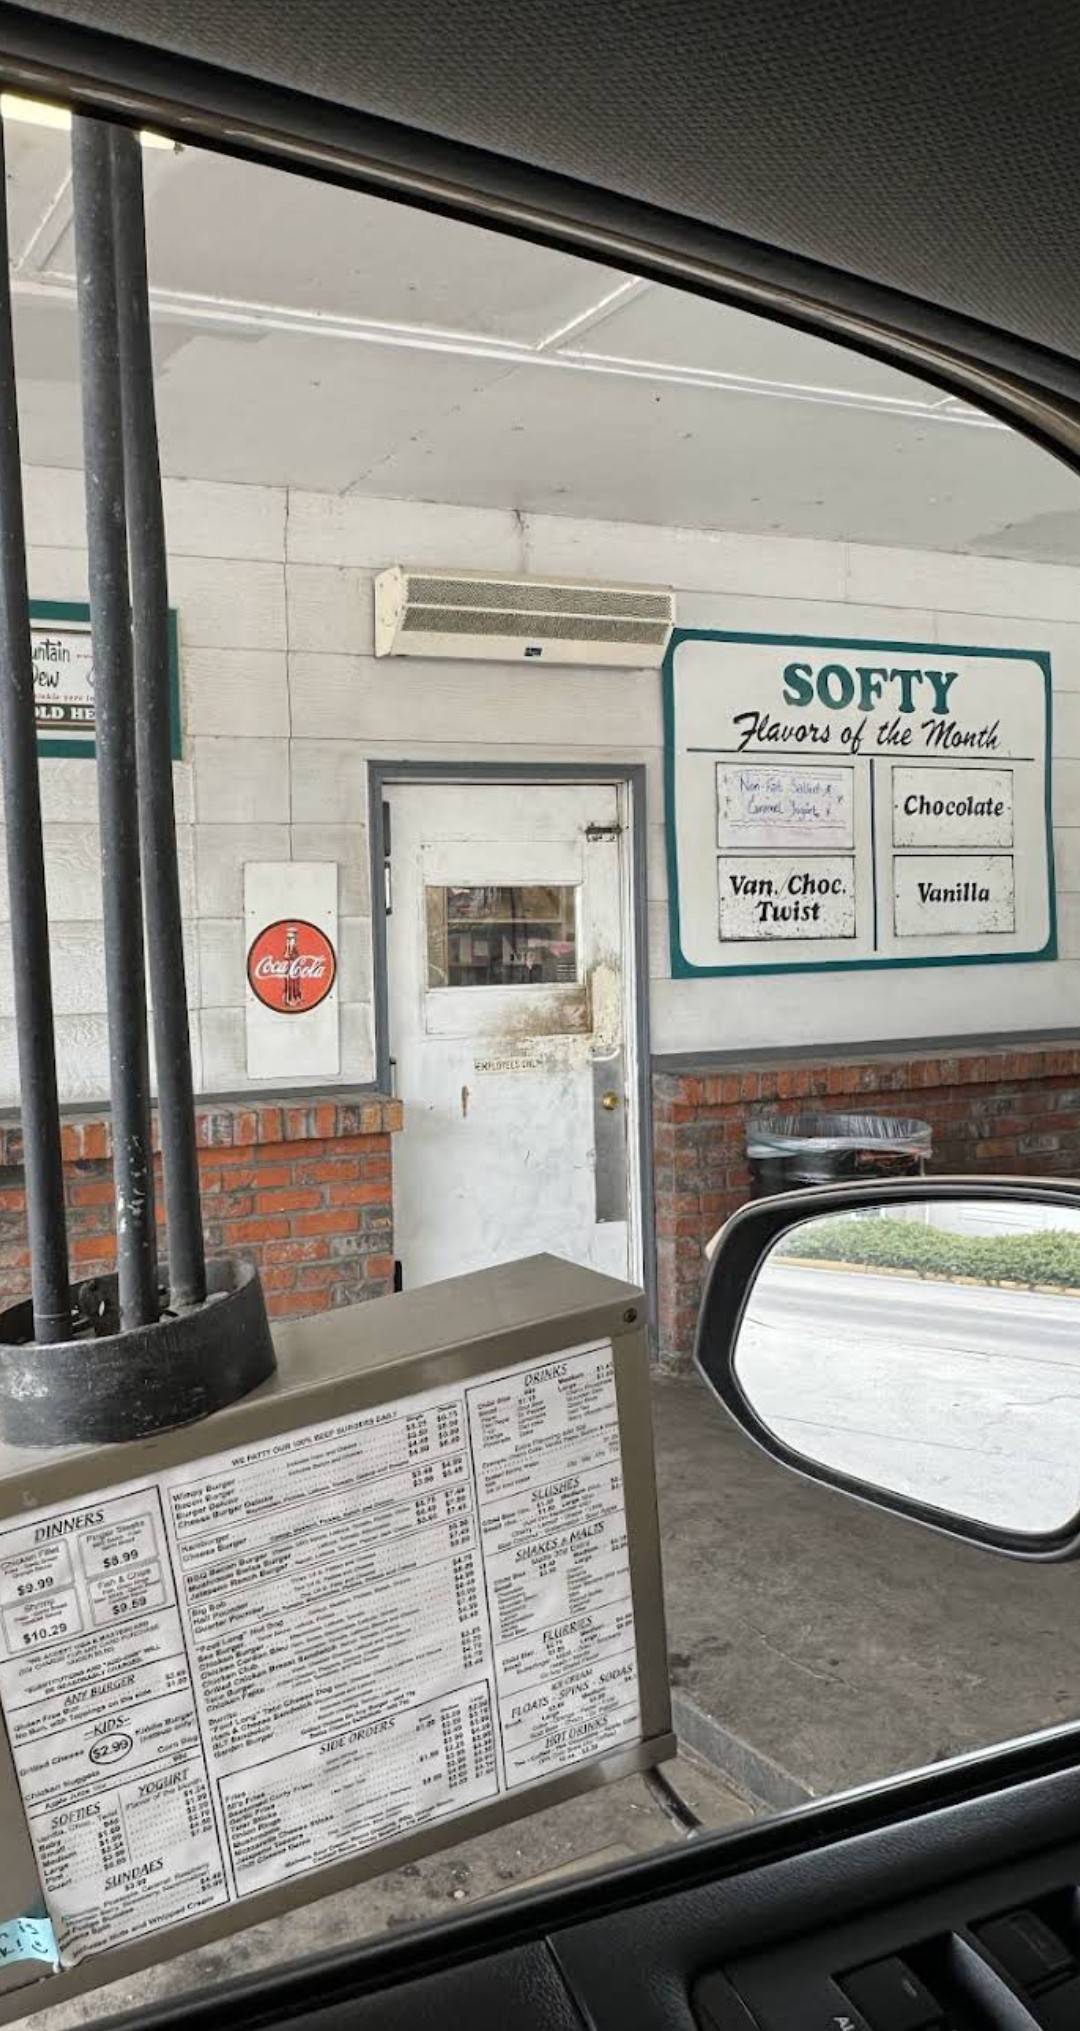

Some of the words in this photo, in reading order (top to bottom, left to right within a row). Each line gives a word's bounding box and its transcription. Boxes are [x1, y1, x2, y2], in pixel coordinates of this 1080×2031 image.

[32, 639, 70, 662] untain
[783, 663, 958, 715] SOFTY
[71, 707, 96, 720] HE
[733, 711, 831, 751] Flavors
[841, 716, 867, 755] of
[876, 717, 912, 746] the
[921, 719, 1001, 750] Month
[904, 794, 1004, 816] Chocolate
[917, 882, 990, 903] Vanilla
[755, 900, 821, 922] Twist
[524, 1363, 568, 1387] DRINKS
[531, 1476, 579, 1502] SLUSHES
[33, 1509, 105, 1543] DINNERS
[515, 1537, 558, 1562] SHAKES
[570, 1520, 604, 1542] MALTS
[17, 1576, 53, 1595] $9.99
[23, 1622, 67, 1644] $10.29
[63, 1690, 87, 1707] ANY
[90, 1674, 135, 1697] BURGER
[93, 1738, 128, 1759] $2.99
[319, 1736, 346, 1754] SIDE
[349, 1718, 395, 1743] ORDERS
[138, 1768, 190, 1797] YOGURT
[50, 1801, 101, 1829] SOFTIES
[103, 1857, 164, 1890] SUNDAES
